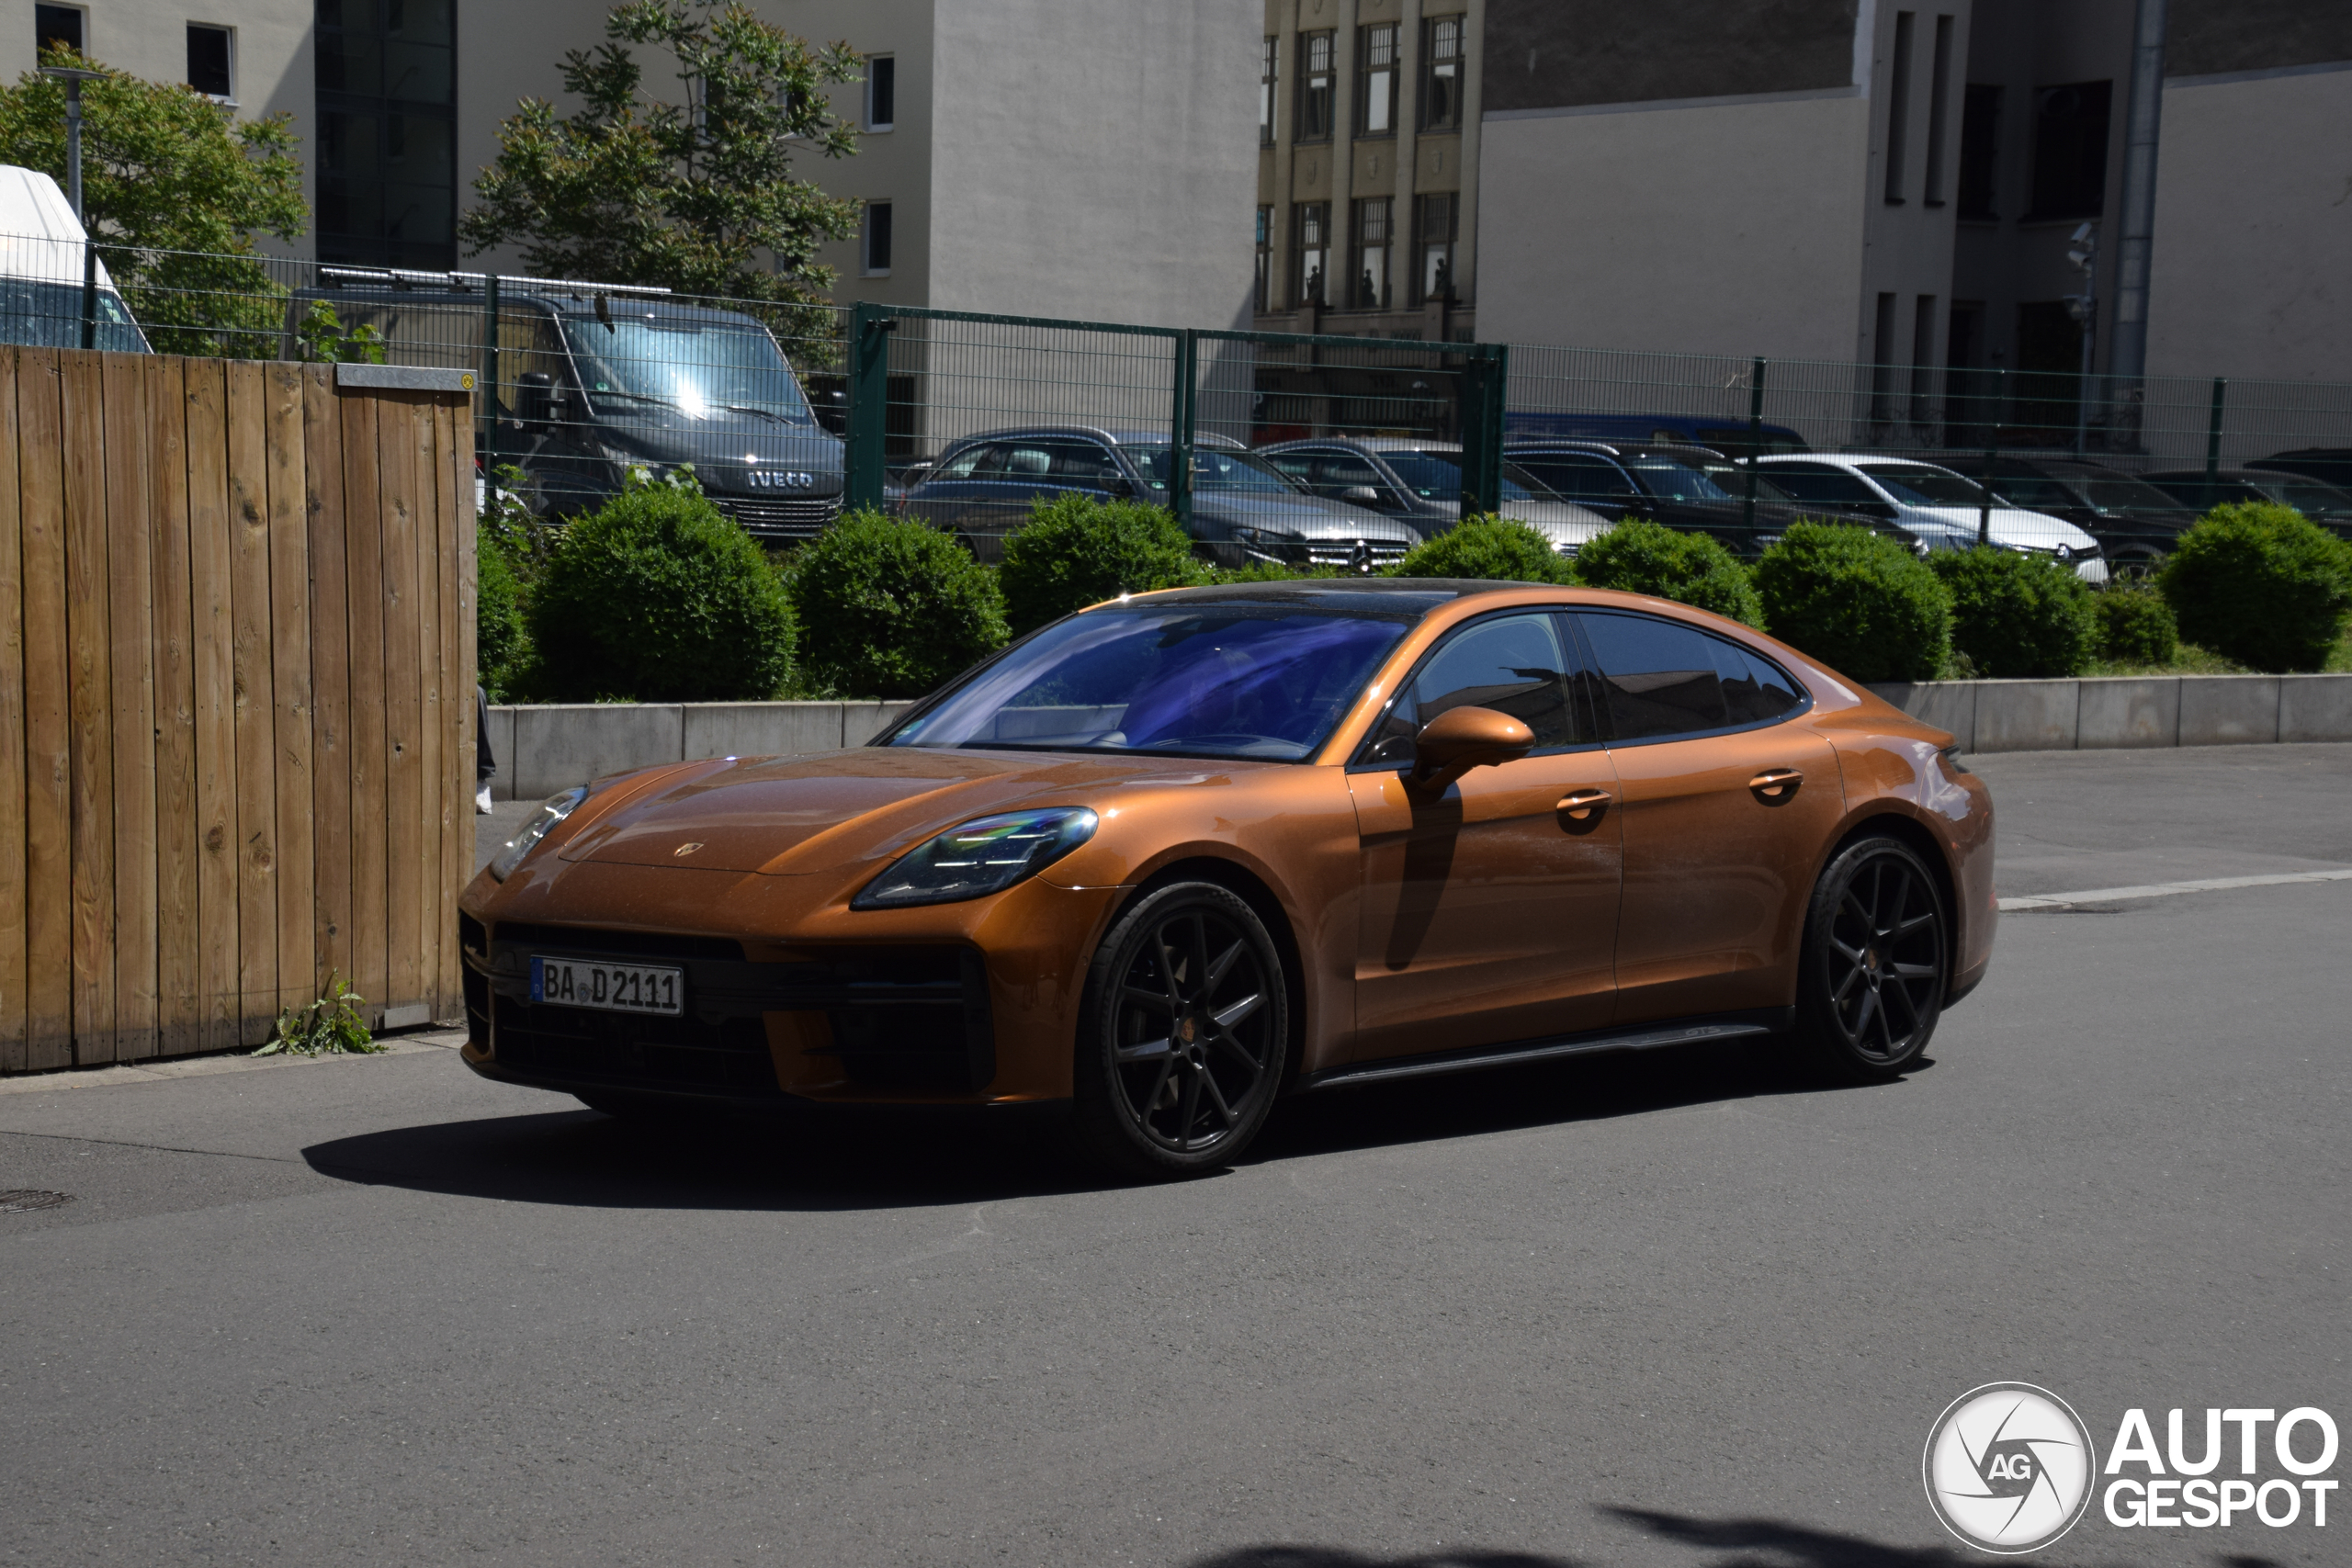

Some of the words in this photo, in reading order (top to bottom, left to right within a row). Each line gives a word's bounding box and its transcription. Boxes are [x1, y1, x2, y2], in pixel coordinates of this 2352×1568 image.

[748, 471, 813, 488] IVECO
[545, 964, 575, 1000] BA
[1685, 1025, 1722, 1036] GTS
